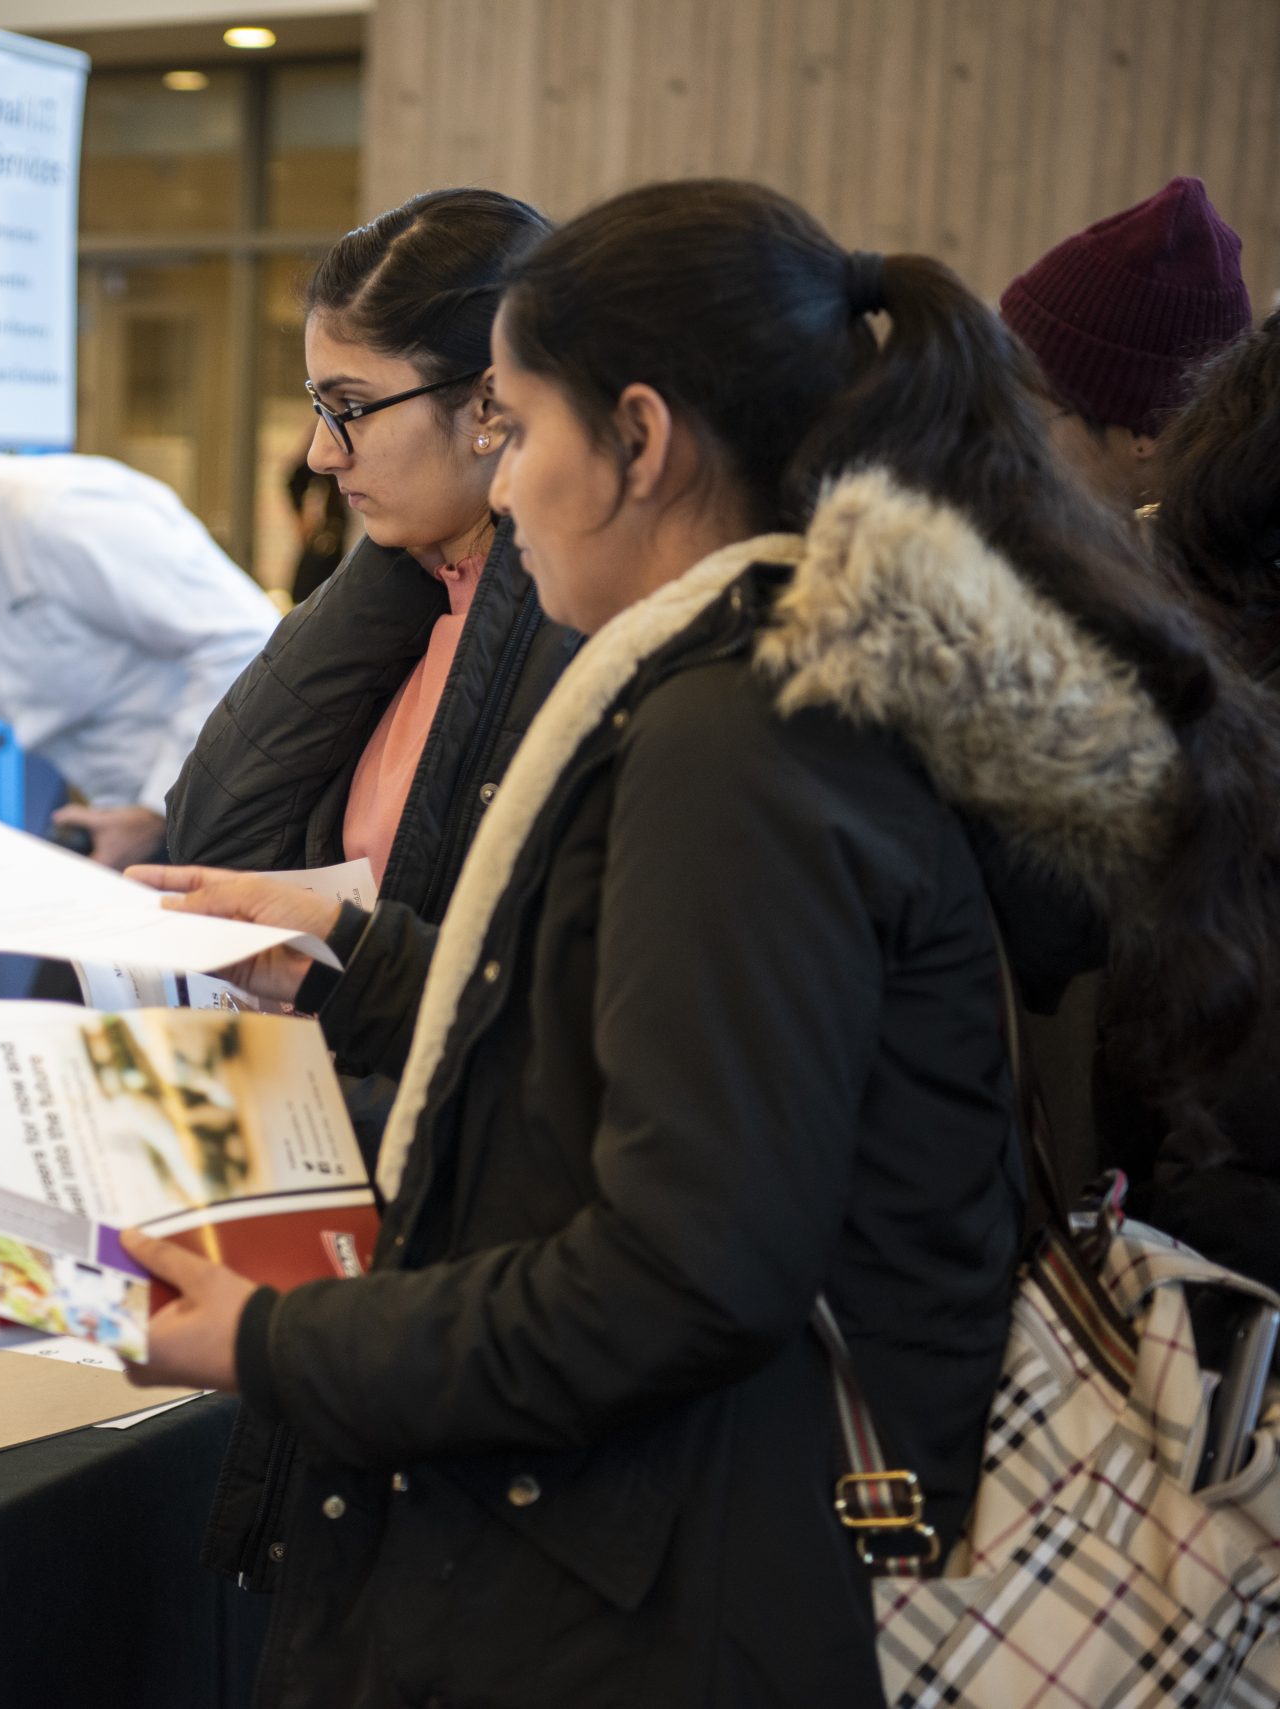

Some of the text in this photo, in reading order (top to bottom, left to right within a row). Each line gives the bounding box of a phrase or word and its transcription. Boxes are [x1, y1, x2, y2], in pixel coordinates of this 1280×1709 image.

[13, 1079, 32, 1116] now
[29, 1054, 55, 1107] future
[23, 1120, 40, 1145] for
[45, 1111, 65, 1141] the
[32, 1150, 61, 1206] areers
